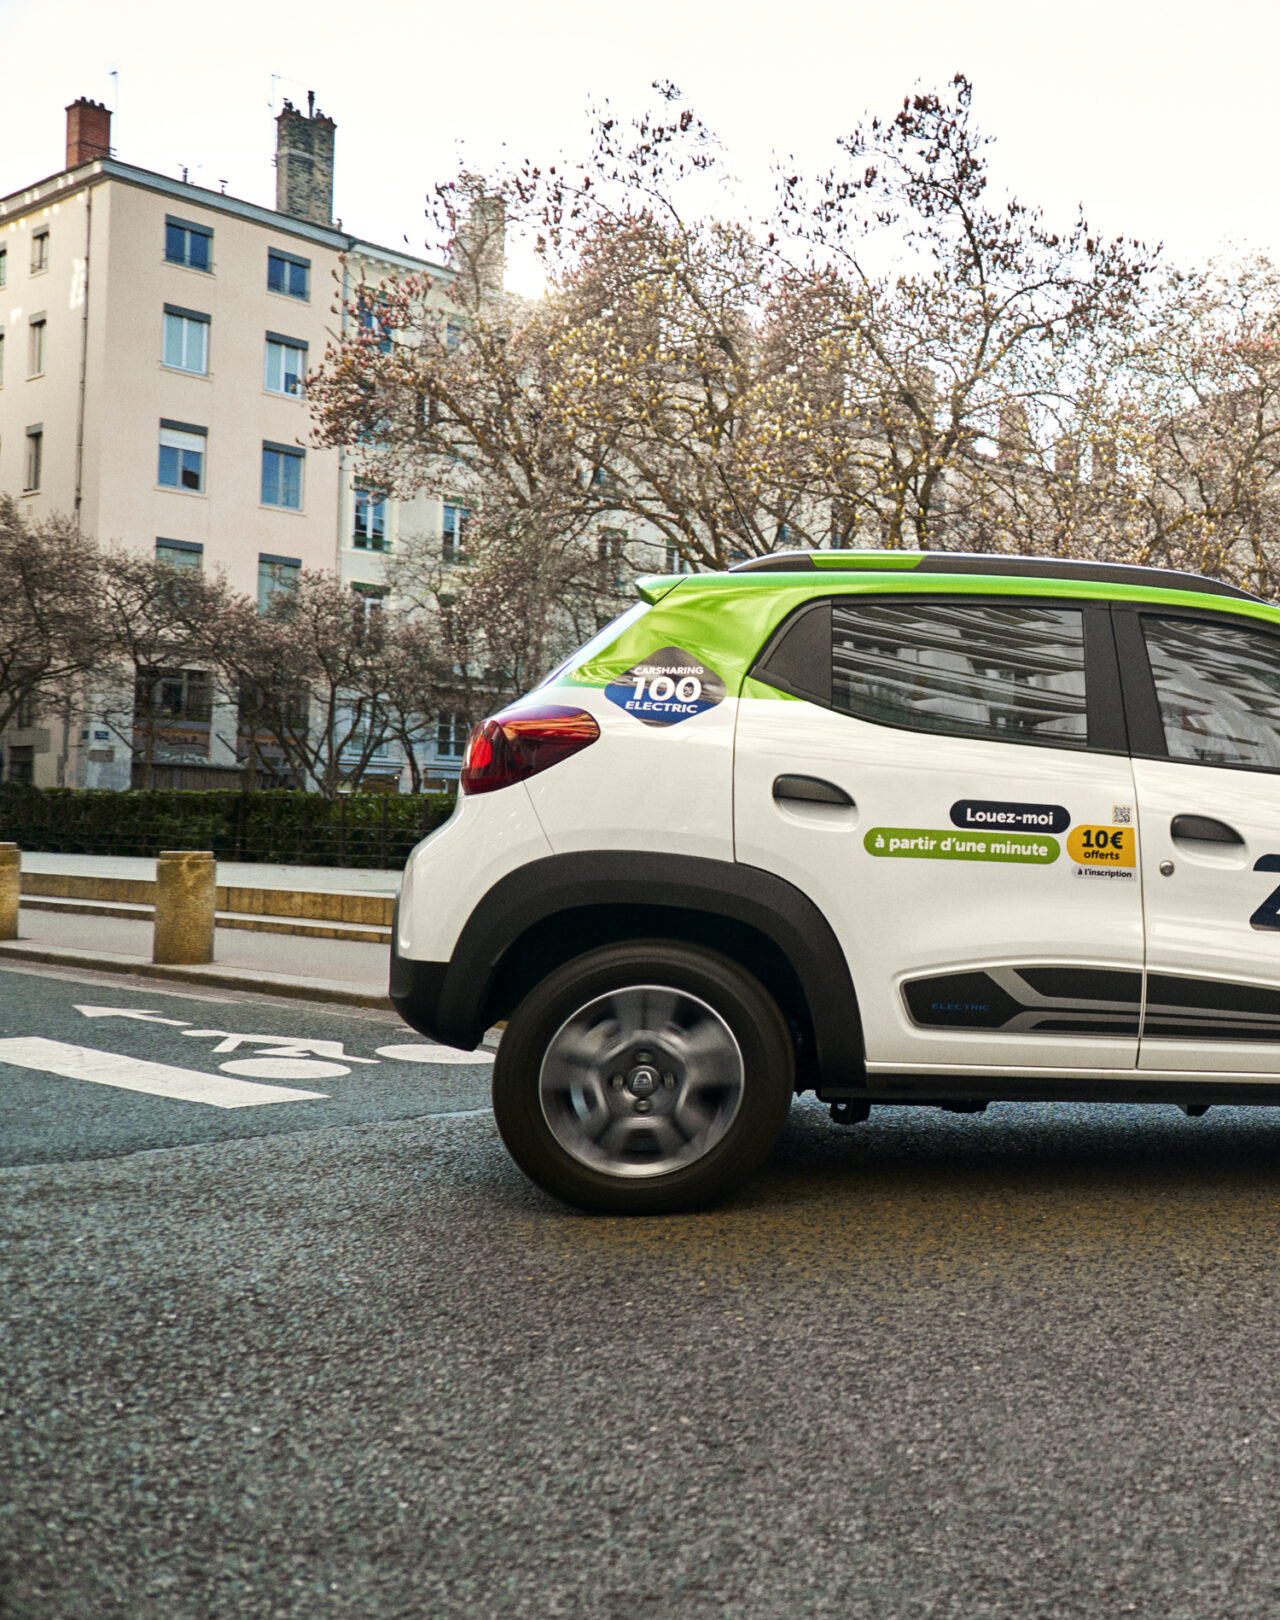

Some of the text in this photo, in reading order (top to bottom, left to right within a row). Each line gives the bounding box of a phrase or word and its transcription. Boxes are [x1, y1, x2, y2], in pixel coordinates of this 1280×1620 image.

[633, 666, 704, 675] CARSHARING
[625, 701, 698, 713] ELECTRIC
[966, 807, 1054, 826] Louez-moi
[874, 834, 1049, 857] à partir d'une minute
[1082, 829, 1124, 850] 10€
[1083, 849, 1120, 861] offerts
[1077, 867, 1132, 879] à l'inscription
[931, 1003, 991, 1012] ELECTRIC
